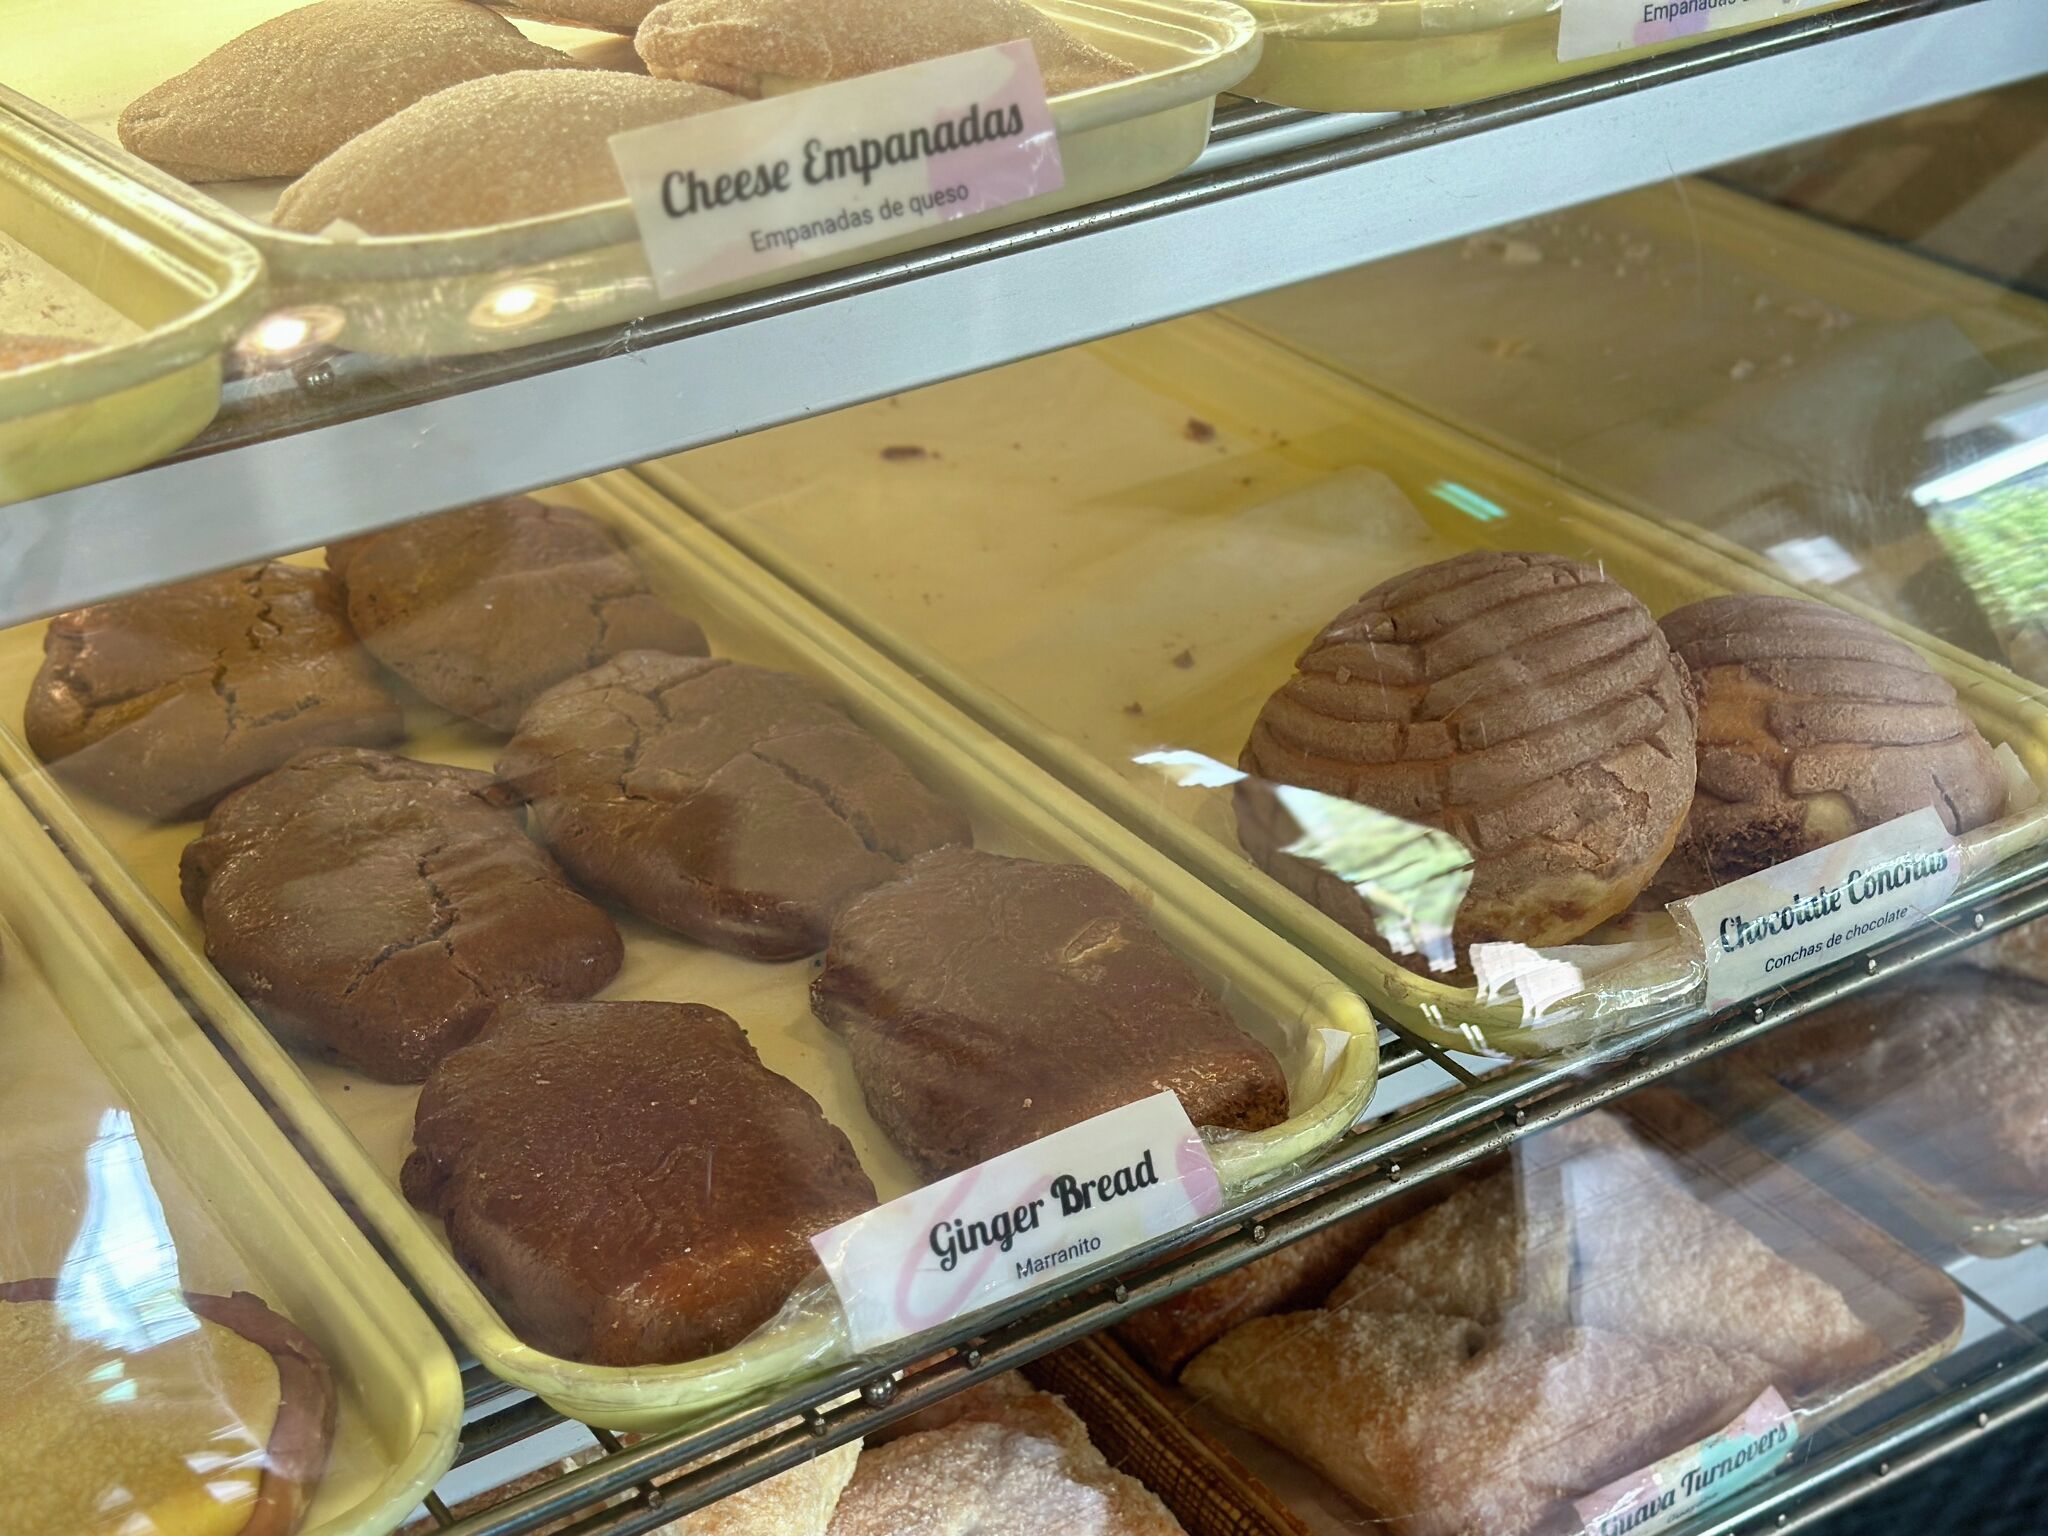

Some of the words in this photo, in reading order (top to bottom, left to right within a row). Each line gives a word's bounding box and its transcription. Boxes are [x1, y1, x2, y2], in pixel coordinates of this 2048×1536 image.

[661, 154, 790, 219] Cheese
[802, 103, 1024, 186] Empanadas
[750, 209, 873, 253] Empanadas
[880, 199, 905, 219] de
[909, 183, 969, 216] queso
[1719, 886, 1842, 953] Chocolate
[1846, 849, 1948, 905] Conchas
[1765, 942, 1822, 973] Conchas
[1826, 932, 1842, 949] de
[1845, 906, 1908, 941] chocolate
[929, 1198, 1044, 1272] Ginger
[1050, 1149, 1159, 1217] Bread
[1016, 1236, 1101, 1280] Marranito
[1681, 1421, 1788, 1498] Turnovers
